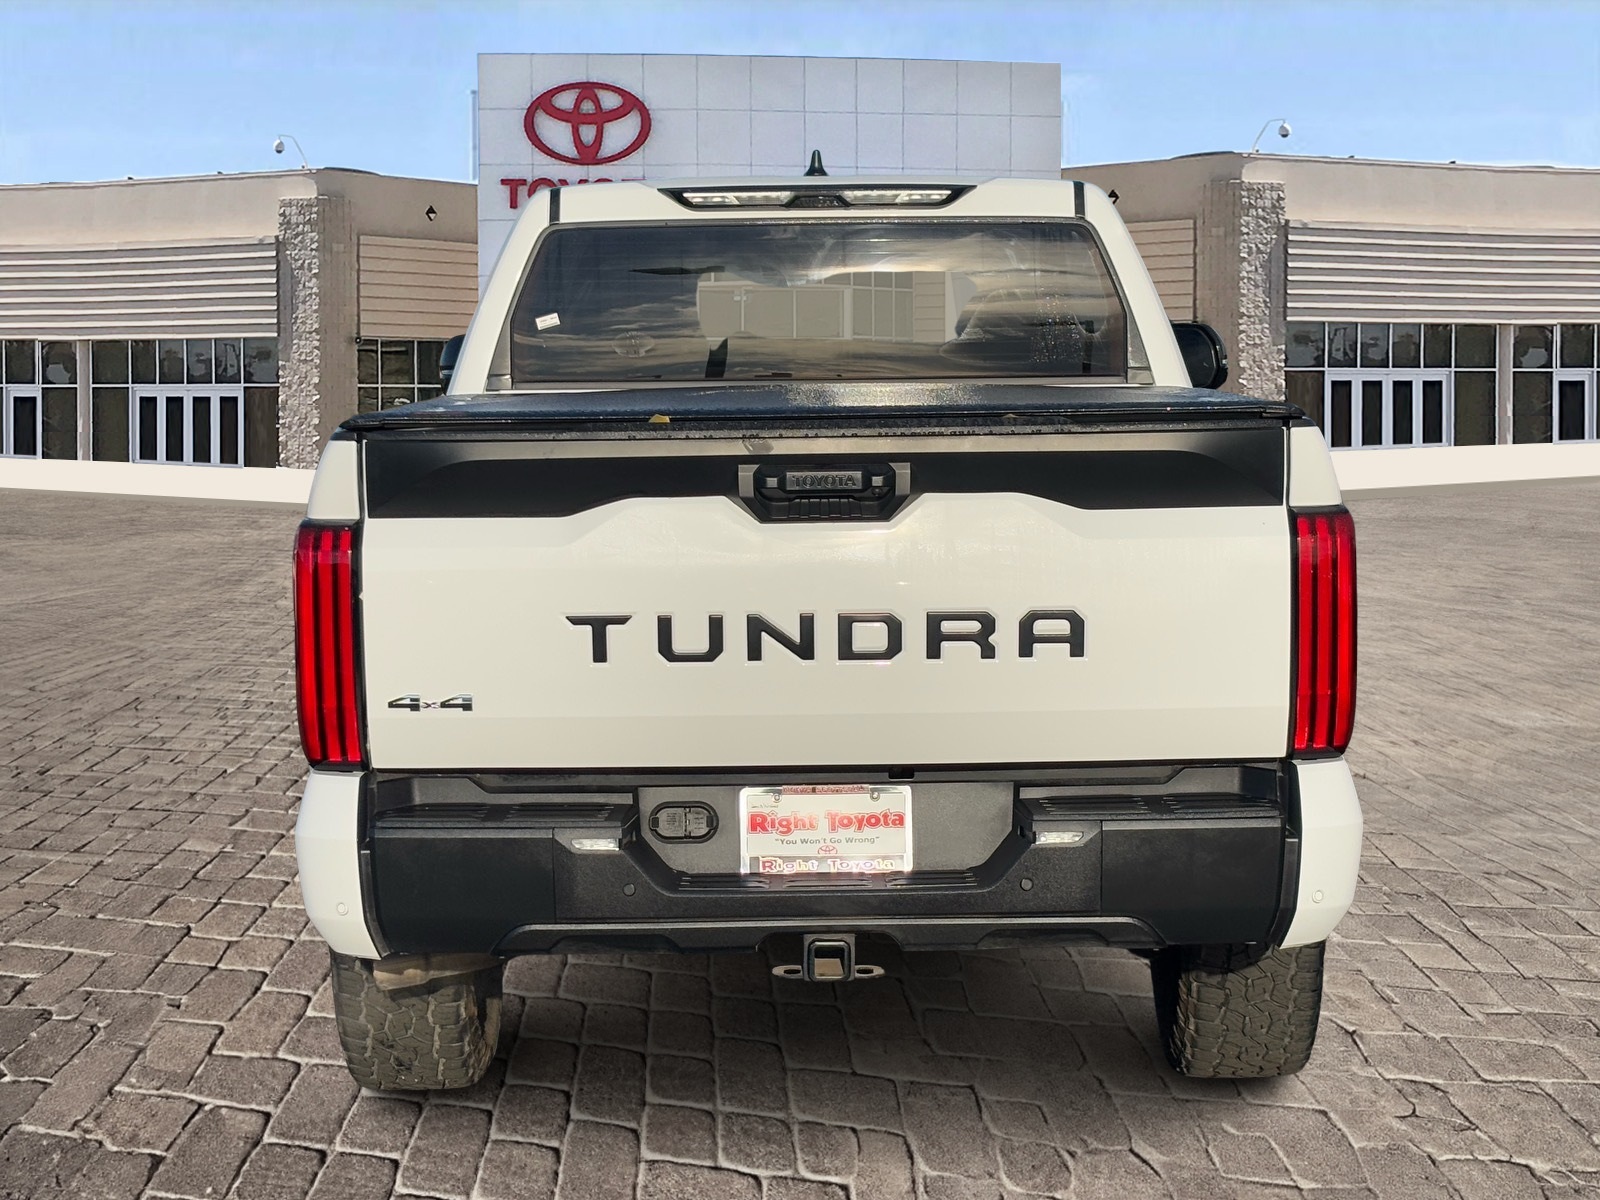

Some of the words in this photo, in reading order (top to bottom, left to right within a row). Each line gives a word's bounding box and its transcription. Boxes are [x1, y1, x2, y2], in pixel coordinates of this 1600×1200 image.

[792, 474, 857, 488] TOYOTA
[565, 609, 1086, 663] TUNDRA
[748, 811, 819, 835] Right
[824, 809, 906, 833] Toyota
[800, 837, 827, 845] Won't
[759, 857, 818, 873] Right
[828, 858, 896, 872] Toyota
